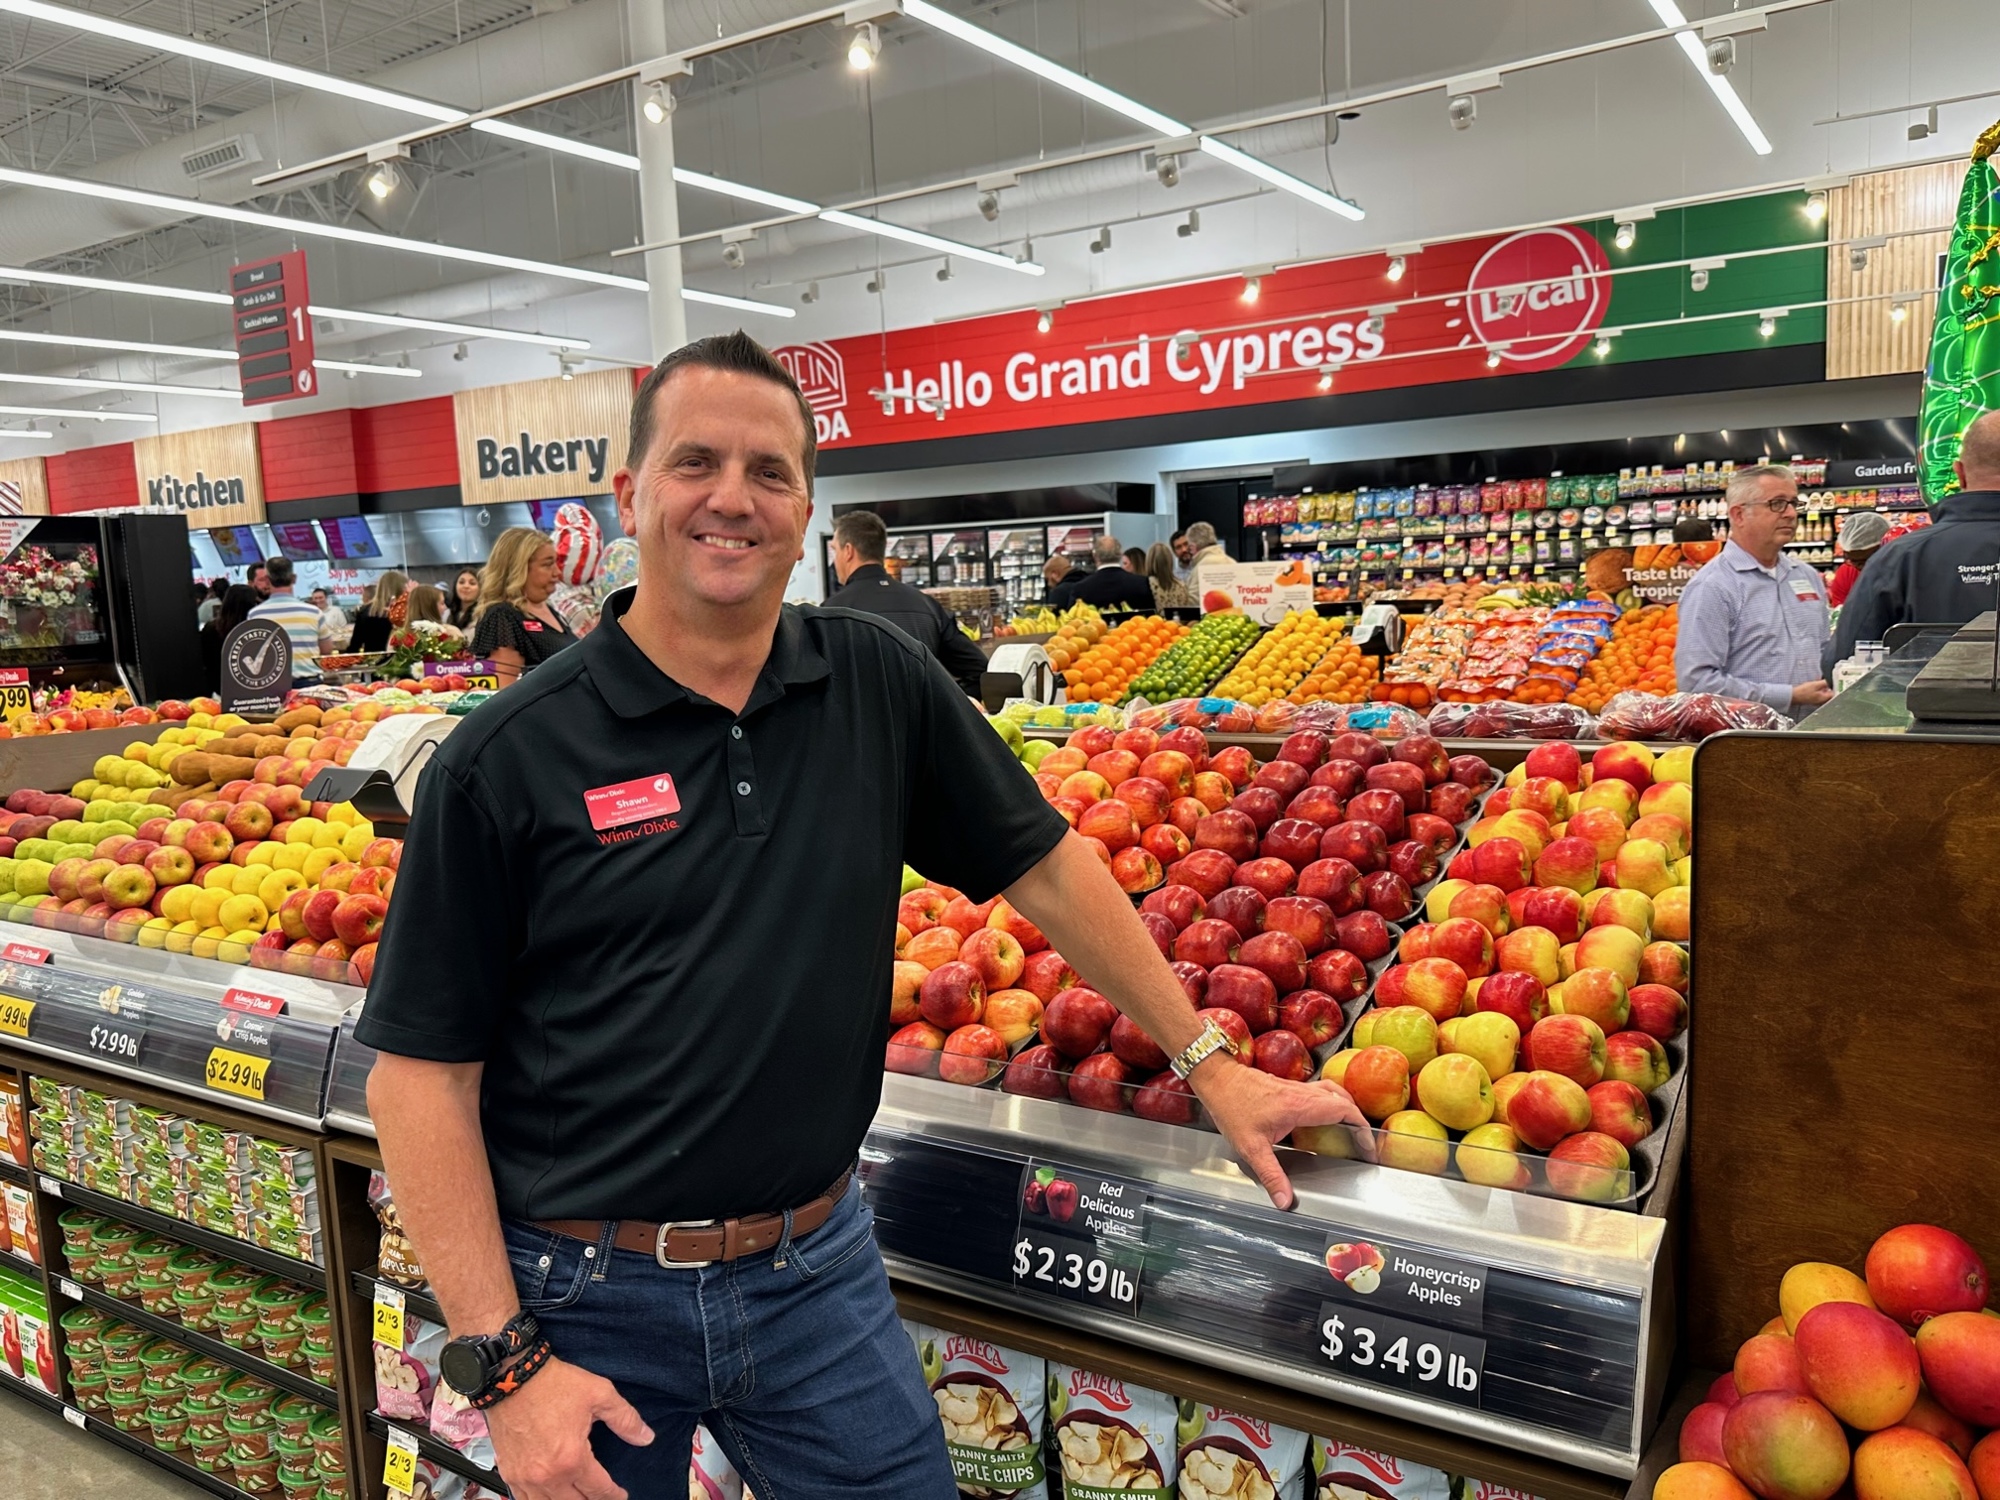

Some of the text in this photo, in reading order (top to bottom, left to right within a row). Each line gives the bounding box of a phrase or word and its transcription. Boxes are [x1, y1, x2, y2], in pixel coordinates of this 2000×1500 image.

[1480, 264, 1586, 323] Lcal
[292, 306, 304, 342] 1
[883, 317, 1385, 416] Hello Grand Cypress
[476, 432, 609, 483] Bakery
[1854, 464, 1901, 477] Garden
[148, 471, 245, 511] Kitchen
[1622, 565, 1698, 581] Taste the
[1957, 565, 1995, 573] Stronger
[1236, 584, 1273, 596] Tropical
[1242, 596, 1268, 606] fruits
[244, 631, 267, 641] TASTE
[436, 663, 472, 675] Organic
[233, 694, 281, 706] Guaranteed fresh
[616, 796, 648, 810] Shawn
[244, 1020, 264, 1032] Cosmic
[234, 1029, 268, 1045] Crisp Apples
[1099, 1181, 1124, 1198] Red
[8, 1206, 25, 1220] APPLE
[1080, 1195, 1135, 1219] Delicious
[1085, 1215, 1127, 1236] Apples
[381, 1256, 407, 1274] APPLE
[1394, 1257, 1481, 1293] Honeycrisp
[1407, 1281, 1462, 1307] Apples
[20, 1335, 37, 1348] APPLE
[942, 1335, 1009, 1370] SENECA
[1068, 1368, 1131, 1404] SENECA
[990, 1452, 1026, 1464] SMITH
[993, 1465, 1035, 1483] CHIPS
[1071, 1487, 1116, 1500] GRANNY
